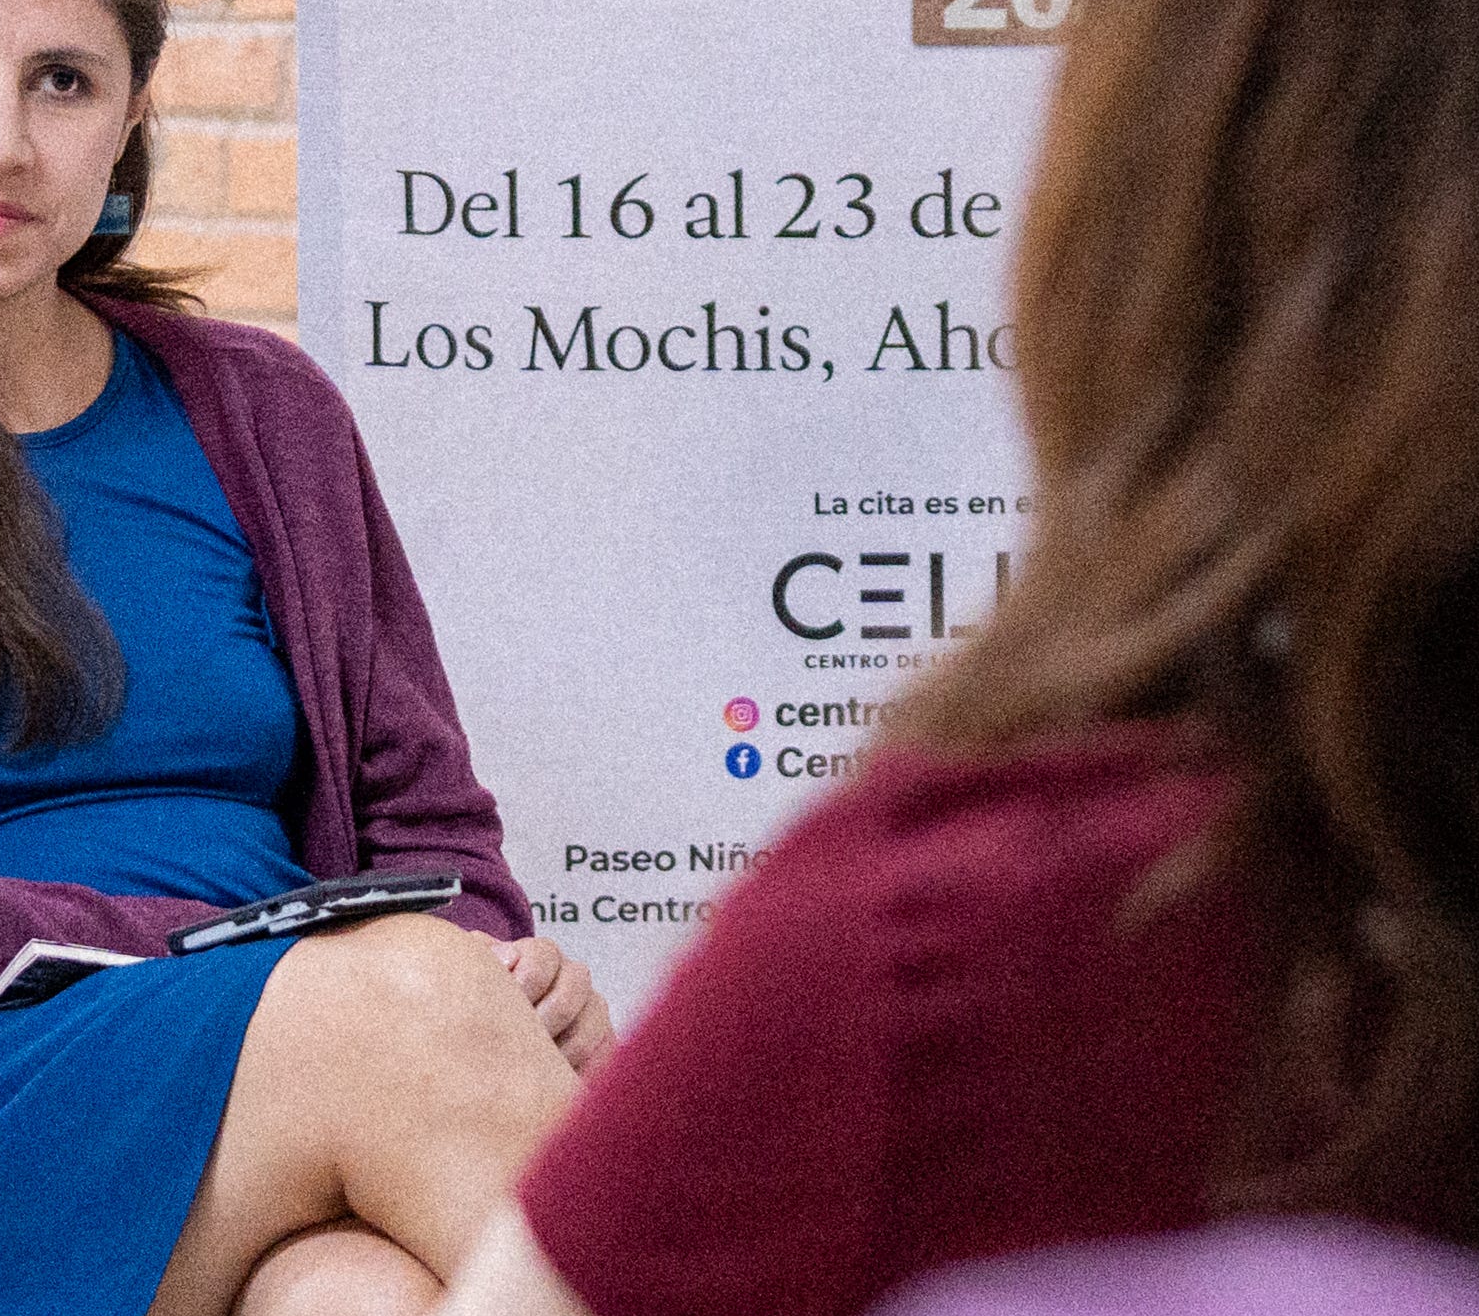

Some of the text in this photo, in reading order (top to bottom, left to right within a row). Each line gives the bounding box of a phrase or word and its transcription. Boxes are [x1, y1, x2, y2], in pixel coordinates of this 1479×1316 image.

[396, 166, 1003, 240] Del 16 al 23 de
[364, 300, 495, 370] Los
[523, 302, 838, 382] Mochis,
[814, 491, 849, 516] La
[858, 490, 915, 516] cita
[924, 496, 959, 516] es
[968, 496, 1006, 516] en
[803, 653, 889, 670] CENTRO
[896, 653, 923, 670] DE
[564, 843, 678, 873] Paseo
